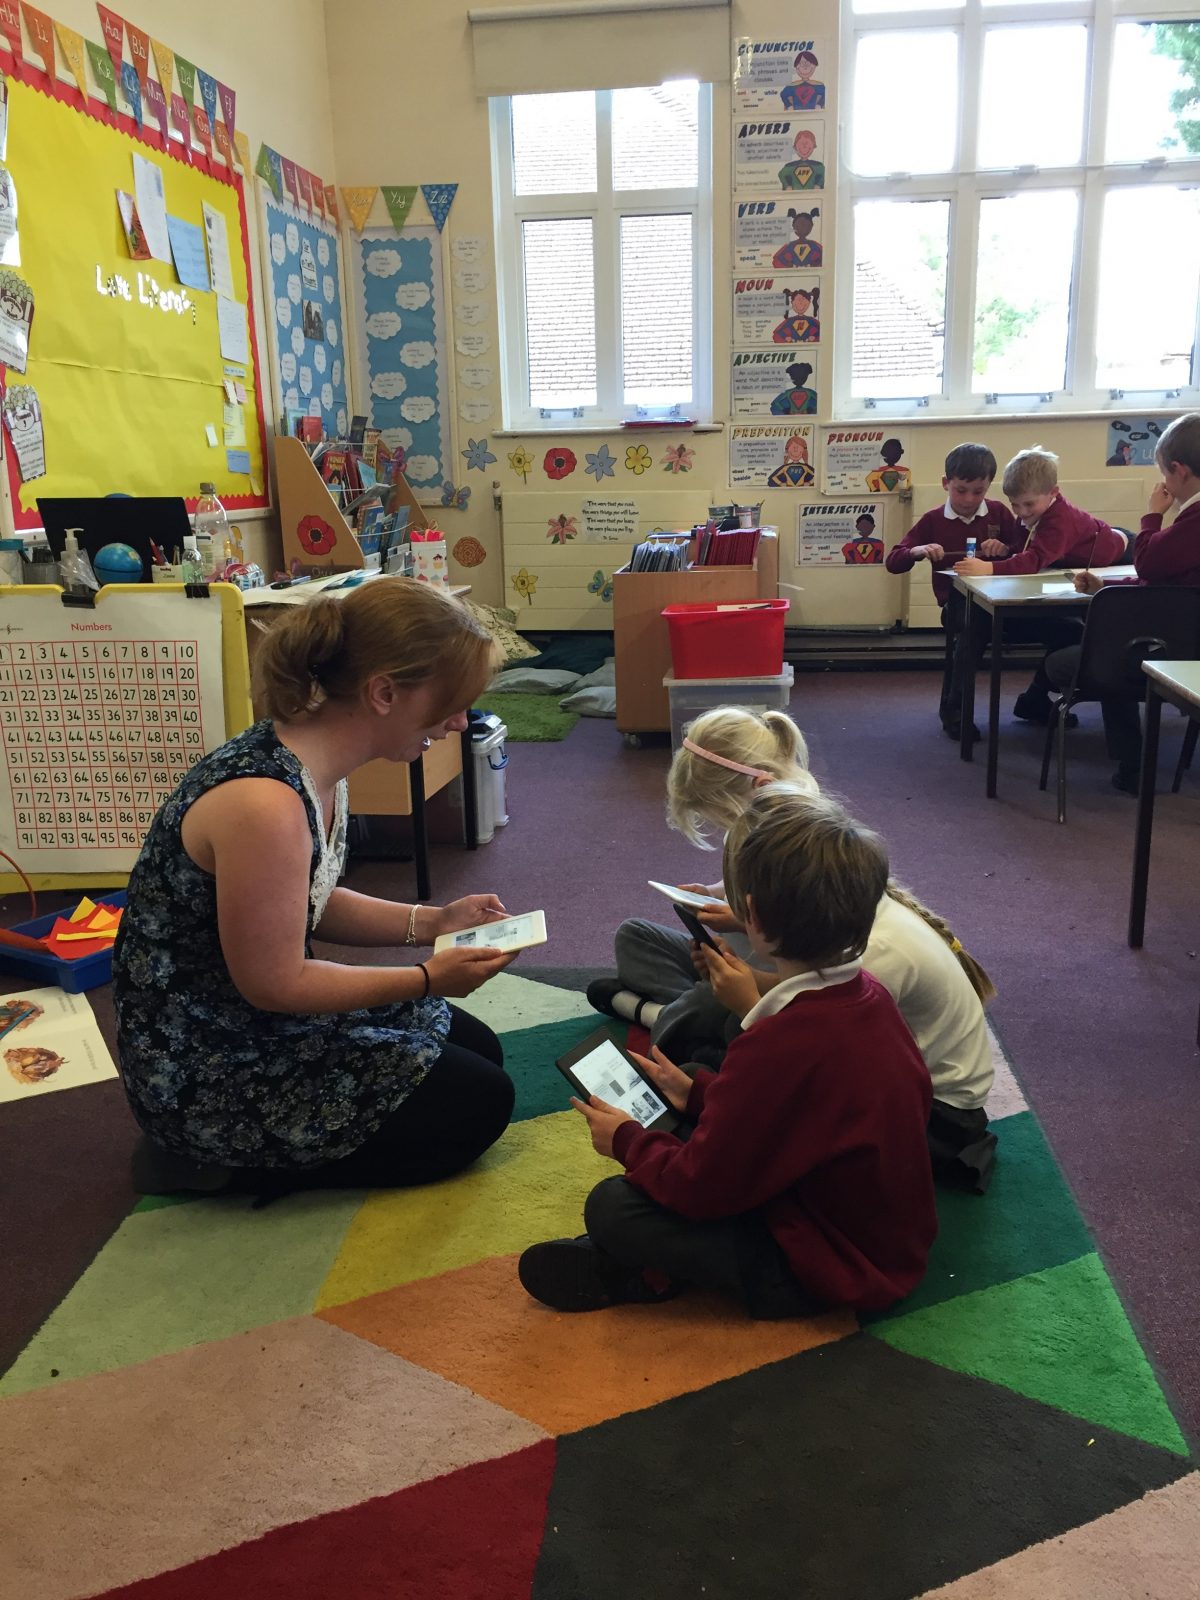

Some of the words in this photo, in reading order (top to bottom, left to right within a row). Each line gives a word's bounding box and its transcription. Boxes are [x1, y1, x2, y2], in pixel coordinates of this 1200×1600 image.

[105, 16, 121, 41] Aa
[132, 35, 146, 59] Bb
[738, 122, 790, 138] ADVERB
[391, 191, 406, 208] Yy
[430, 191, 447, 204] Zz
[738, 202, 776, 218] VERB
[735, 279, 774, 294] NOUN
[733, 352, 797, 366] ADJECTIVE
[732, 426, 811, 440] PREPOSITION
[827, 431, 884, 445] PRONOUN
[802, 505, 876, 516] INTERJECTION
[71, 623, 113, 632] Numbers
[18, 648, 26, 660] 2
[40, 648, 48, 659] 3
[60, 647, 68, 660] 4
[82, 647, 90, 660] 5
[102, 647, 110, 660] 6
[121, 646, 128, 659] 7
[141, 646, 149, 659] 8
[162, 646, 169, 659] 9
[180, 646, 194, 659] 10
[20, 669, 33, 680] 12
[41, 669, 54, 680] 13
[62, 669, 75, 680] 14
[82, 669, 96, 680] 15
[103, 669, 116, 680] 16
[122, 669, 134, 680] 17
[142, 669, 154, 680] 18
[162, 669, 174, 680] 19
[181, 669, 195, 680] 20
[2, 690, 14, 701] 21
[21, 690, 37, 701] 22
[42, 690, 57, 701] 23
[63, 690, 78, 701] 24
[84, 690, 99, 701] 25
[105, 690, 119, 701] 26
[123, 690, 136, 701] 27
[143, 690, 156, 701] 28
[162, 690, 176, 701] 29
[182, 690, 196, 701] 30
[6, 711, 17, 722] 31
[24, 711, 40, 722] 32
[45, 711, 60, 722] 33
[66, 711, 81, 722] 34
[87, 711, 101, 722] 35
[107, 711, 121, 722] 36
[126, 711, 139, 722] 37
[146, 711, 159, 722] 38
[165, 711, 178, 722] 39
[184, 711, 198, 722] 40
[8, 732, 20, 743] 41
[27, 732, 43, 743] 42
[48, 732, 63, 743] 43
[69, 732, 84, 743] 44
[89, 732, 104, 743] 45
[109, 732, 123, 743] 46
[128, 732, 141, 743] 47
[148, 732, 162, 743] 48
[167, 732, 180, 743] 49
[186, 732, 200, 743] 50
[11, 752, 23, 763] 51
[32, 752, 46, 763] 52
[52, 752, 65, 763] 53
[72, 752, 87, 763] 54
[93, 752, 106, 763] 55
[113, 752, 126, 763] 56
[131, 752, 144, 763] 57
[151, 752, 165, 763] 58
[170, 752, 183, 763] 59
[189, 752, 202, 763] 60
[14, 772, 26, 783] 61
[34, 772, 48, 783] 62
[54, 772, 68, 783] 63
[75, 772, 89, 783] 64
[95, 772, 109, 783] 65
[115, 772, 129, 783] 66
[134, 772, 147, 783] 67
[154, 772, 168, 783] 68
[17, 792, 29, 803] 71
[36, 792, 51, 803] 72
[57, 792, 70, 803] 73
[77, 792, 92, 803] 74
[97, 792, 111, 803] 75
[117, 792, 131, 803] 76
[137, 792, 149, 803] 77
[157, 792, 169, 803] 78
[19, 812, 31, 823] 81
[39, 812, 53, 823] 82
[59, 812, 73, 823] 83
[79, 812, 94, 823] 84
[99, 812, 113, 823] 85
[120, 812, 133, 823] 86
[139, 812, 152, 823] 87
[22, 832, 33, 844] 91
[41, 832, 55, 844] 92
[61, 832, 75, 844] 93
[81, 832, 96, 844] 94
[101, 832, 115, 844] 95
[122, 832, 136, 844] 96
